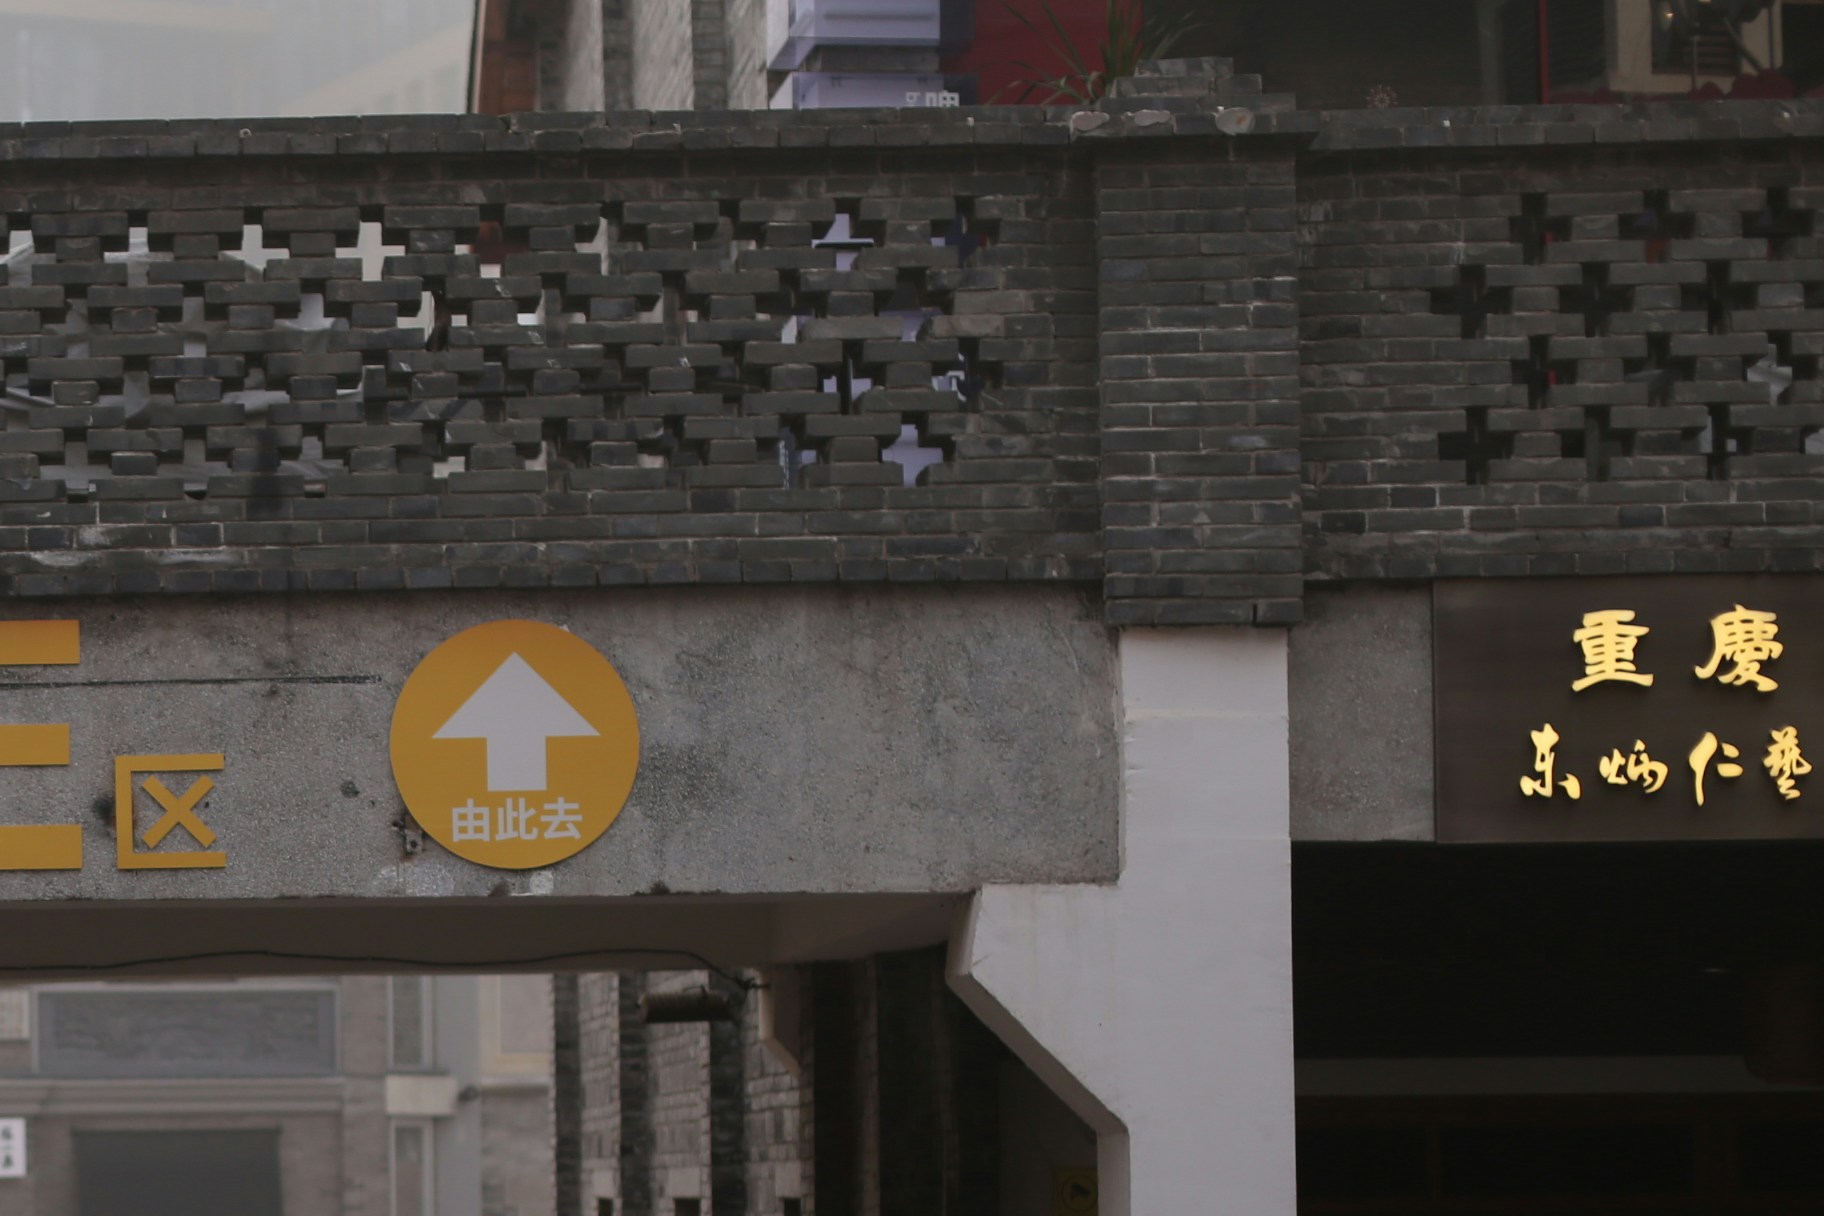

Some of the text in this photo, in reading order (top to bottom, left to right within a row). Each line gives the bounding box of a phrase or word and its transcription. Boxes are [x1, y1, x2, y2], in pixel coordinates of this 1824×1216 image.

[1572, 604, 1783, 692] 重慶
[451, 796, 584, 842] 由此去
